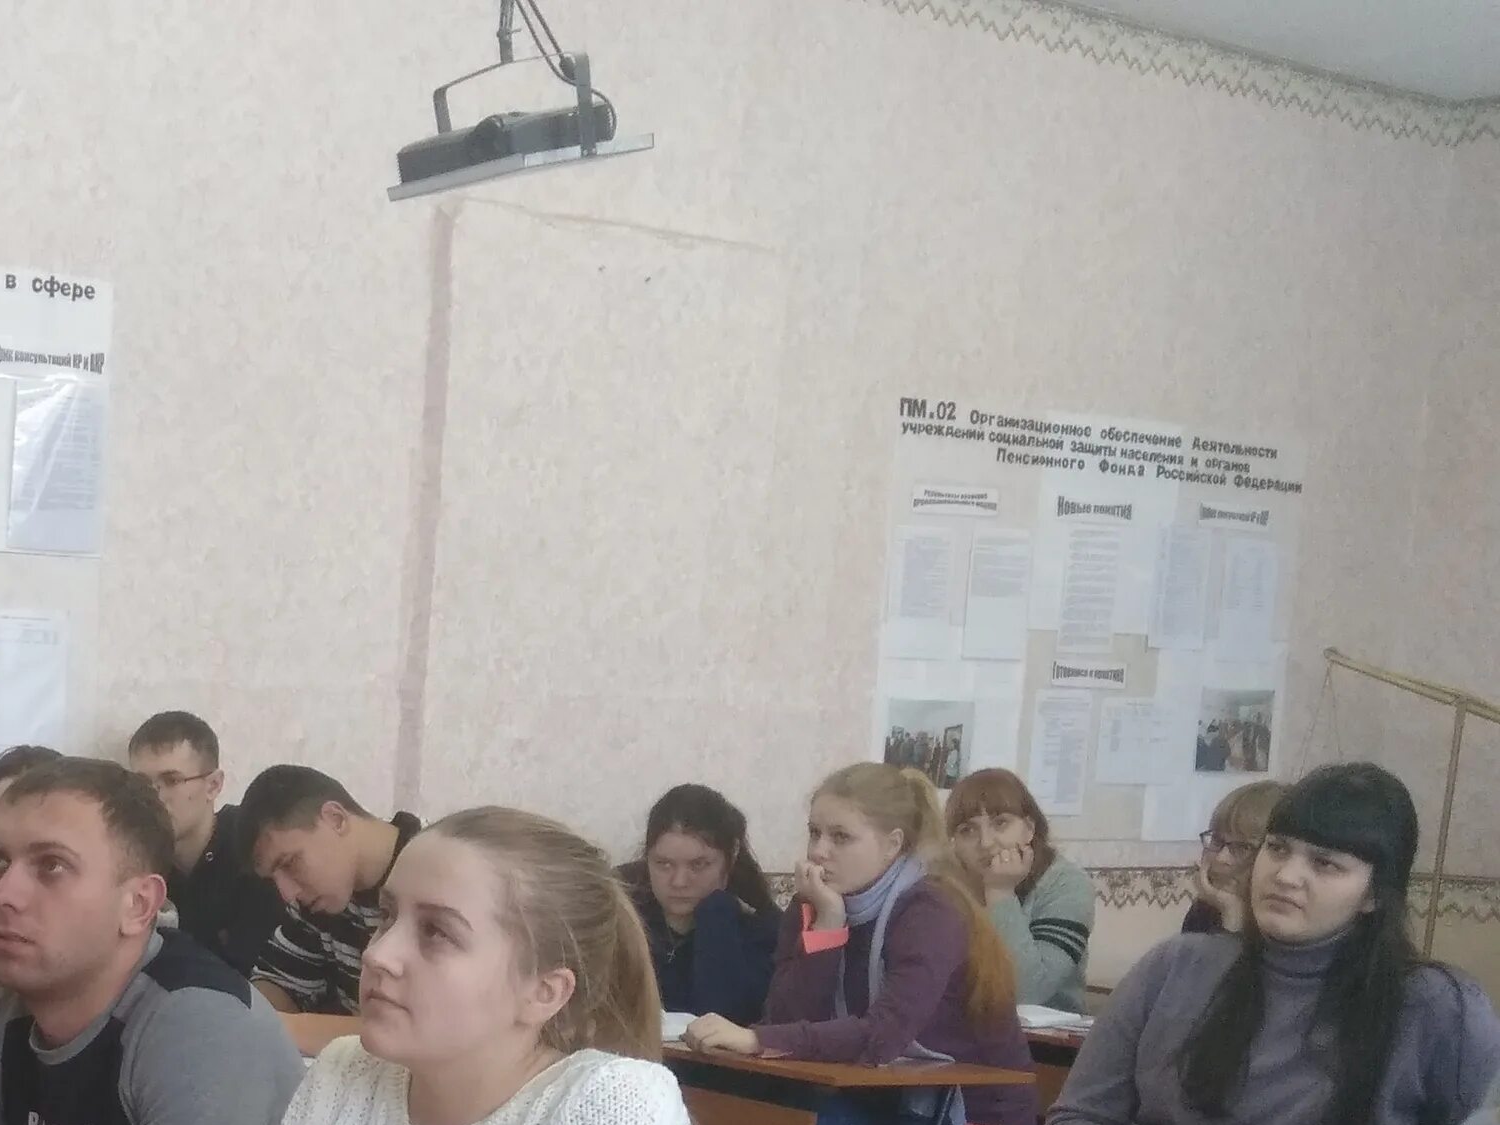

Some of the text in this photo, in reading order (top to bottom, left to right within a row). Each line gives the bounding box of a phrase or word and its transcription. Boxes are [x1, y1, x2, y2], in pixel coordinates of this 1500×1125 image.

[5, 274, 16, 290] в
[32, 275, 96, 303] сфере
[900, 397, 957, 421] ПМ.02
[970, 409, 1092, 437] Организационное
[1100, 426, 1182, 448] обеспечение
[996, 448, 1303, 495] Пенсионного Фонда Российской Федерации
[1070, 440, 1117, 460] защиты
[1120, 446, 1184, 466] населения
[1190, 457, 1198, 468] и
[1204, 457, 1251, 474] органов
[1057, 495, 1092, 517] Новые
